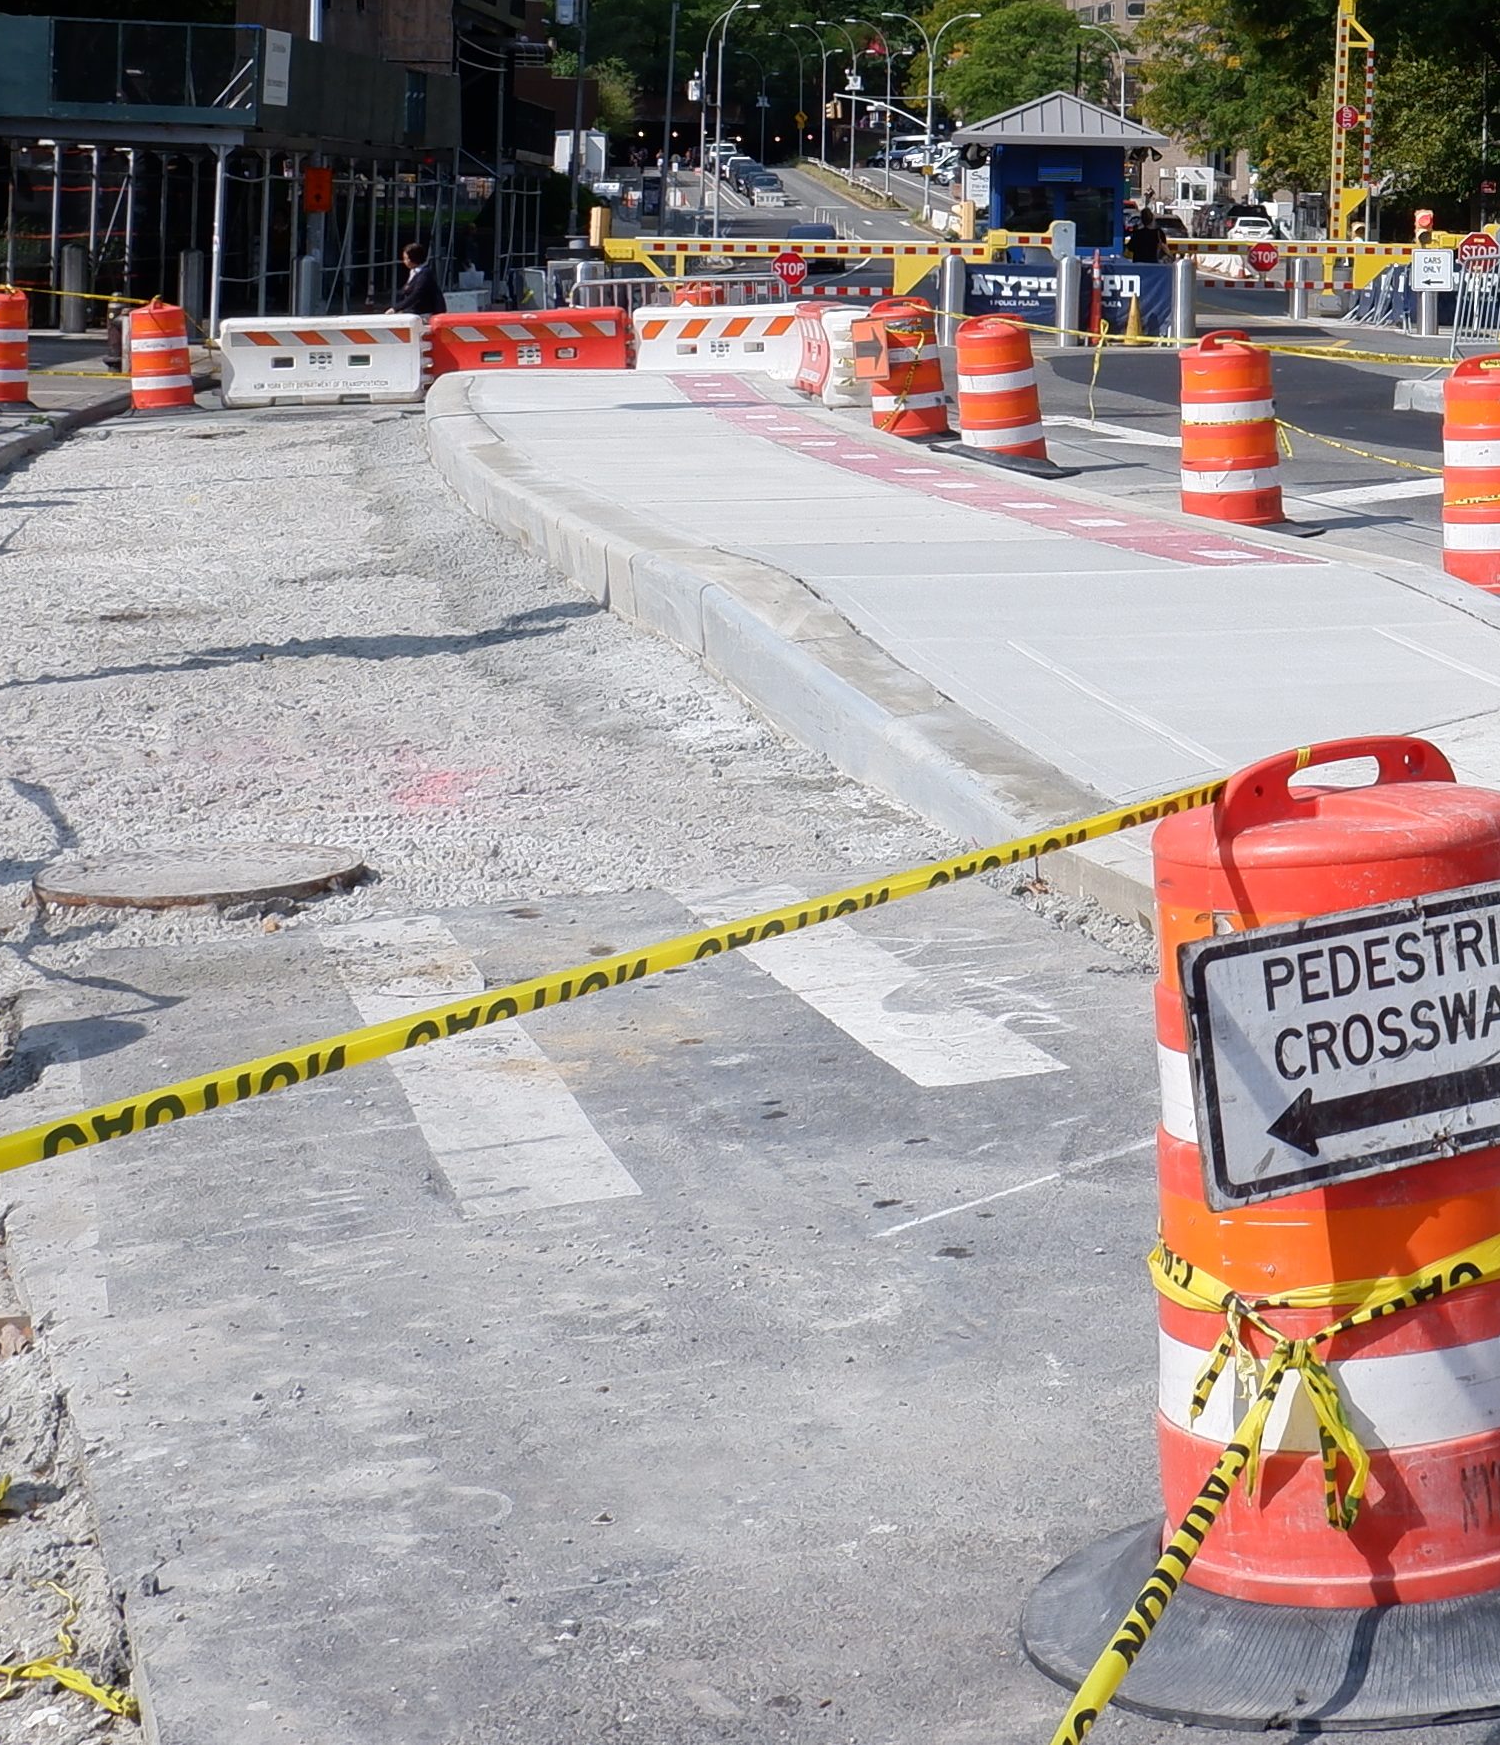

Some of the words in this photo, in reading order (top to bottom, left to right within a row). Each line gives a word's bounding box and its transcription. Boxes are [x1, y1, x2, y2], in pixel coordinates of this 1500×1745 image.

[1343, 108, 1352, 128] STOP
[1252, 251, 1278, 264] STOP
[1462, 246, 1498, 259] STOP
[1423, 257, 1442, 265] CARS
[774, 263, 805, 275] STOP
[1423, 265, 1442, 273] ONLY
[971, 274, 1057, 297] NYPD
[995, 299, 1017, 307] POLICE
